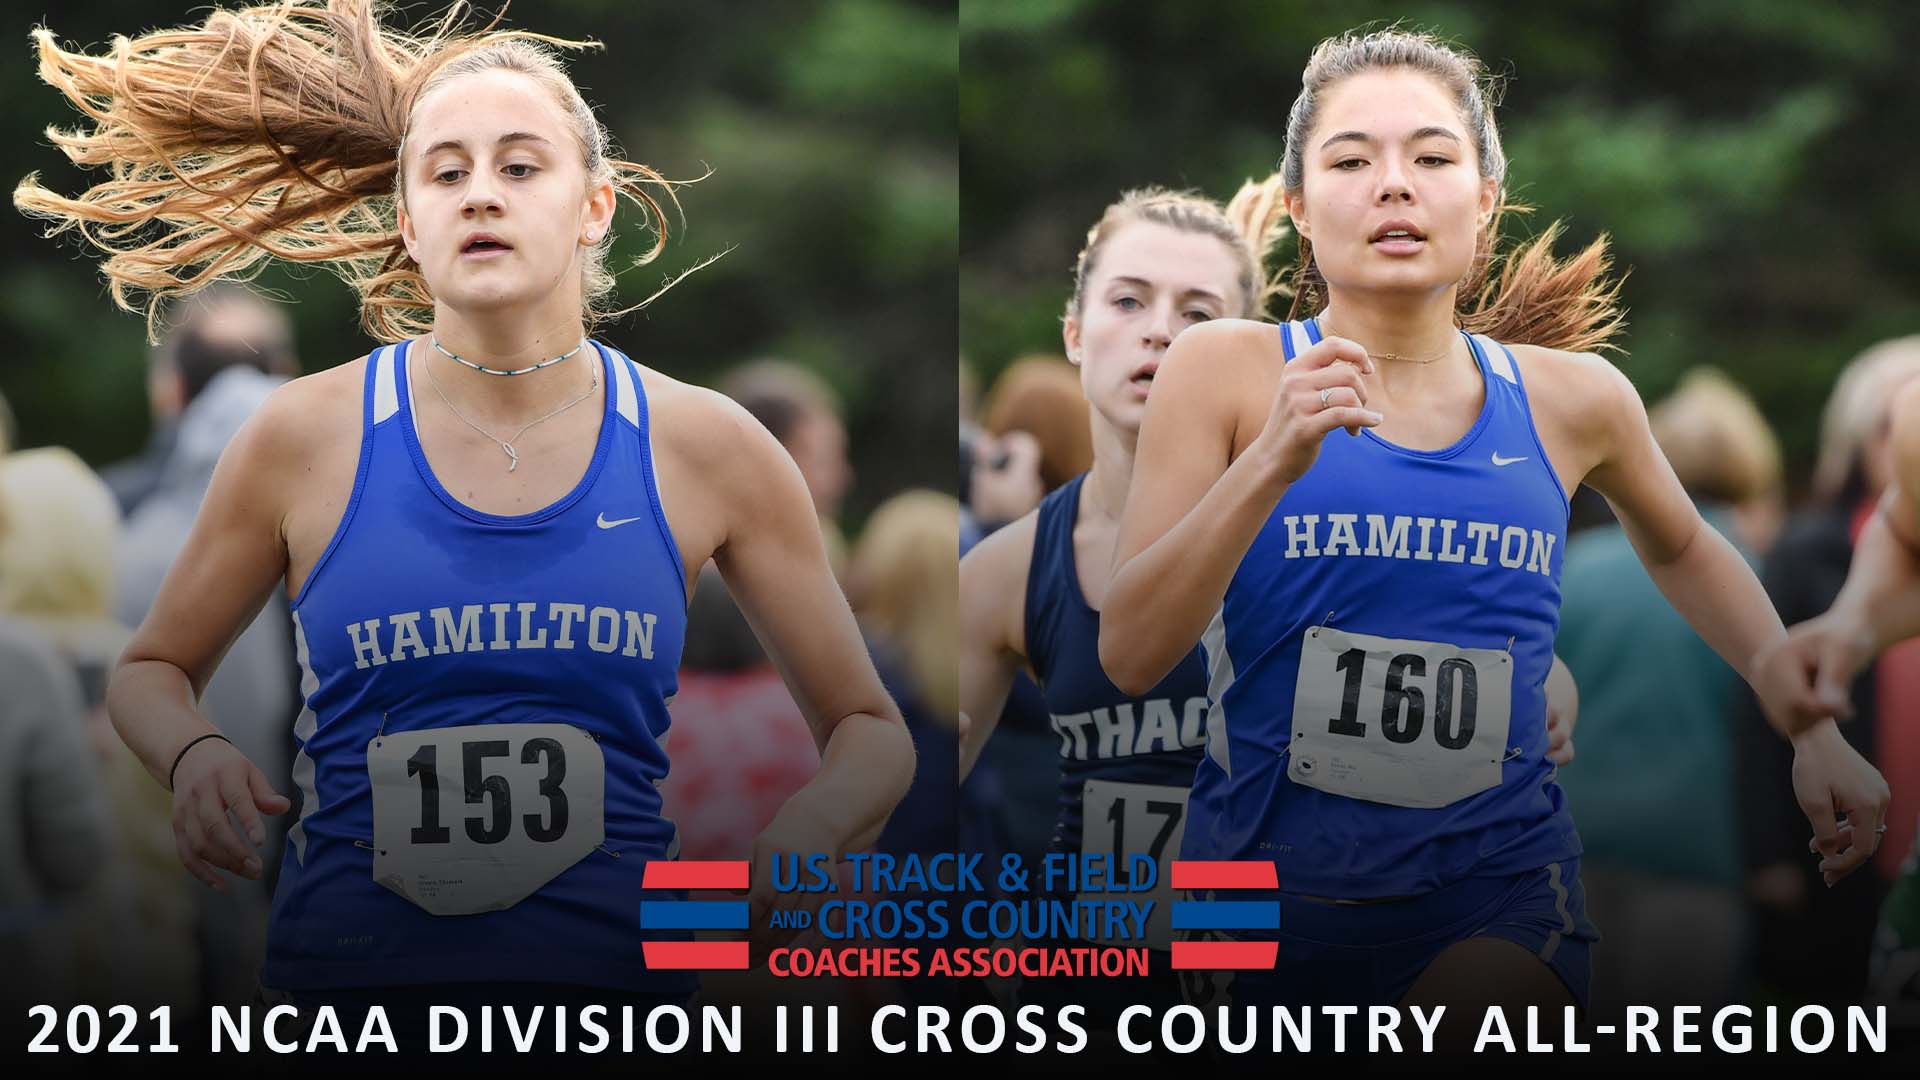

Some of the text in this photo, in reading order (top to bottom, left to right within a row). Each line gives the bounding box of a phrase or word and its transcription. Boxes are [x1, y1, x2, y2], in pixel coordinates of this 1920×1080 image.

[1284, 514, 1556, 577] HAMILTON
[347, 602, 657, 669] HAMILTON
[1328, 648, 1479, 751] 160
[407, 737, 570, 845] 153
